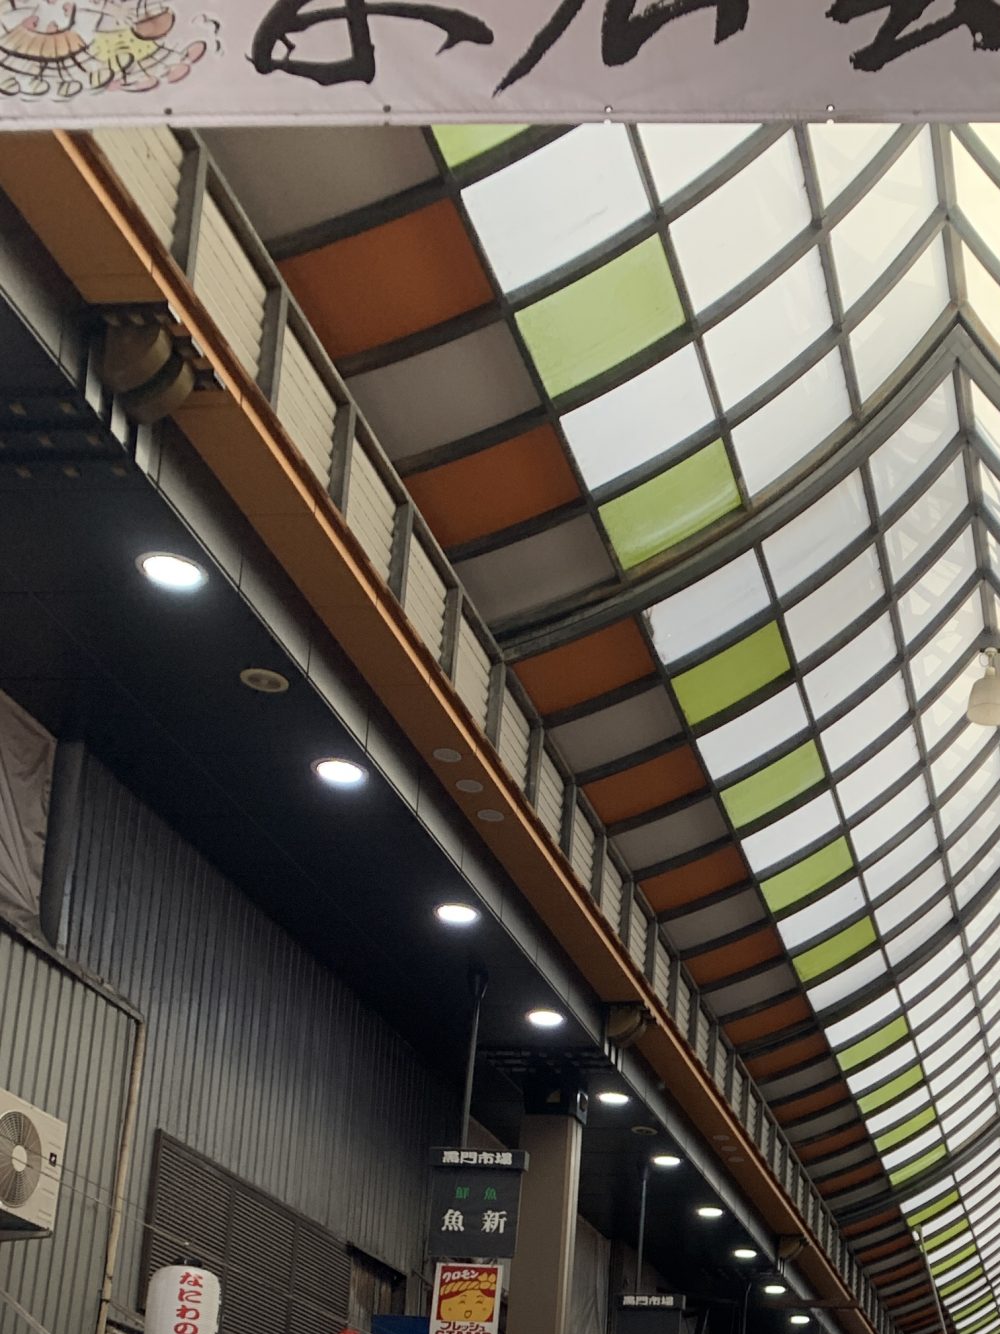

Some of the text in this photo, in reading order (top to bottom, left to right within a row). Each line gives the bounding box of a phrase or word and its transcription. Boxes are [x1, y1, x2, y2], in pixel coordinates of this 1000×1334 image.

[442, 1151, 513, 1166] 黒門市場
[455, 1187, 497, 1200] 鮮魚
[441, 1209, 508, 1234] 魚新
[442, 1270, 479, 1283] クロモン
[440, 1321, 486, 1332] フレッシュ
